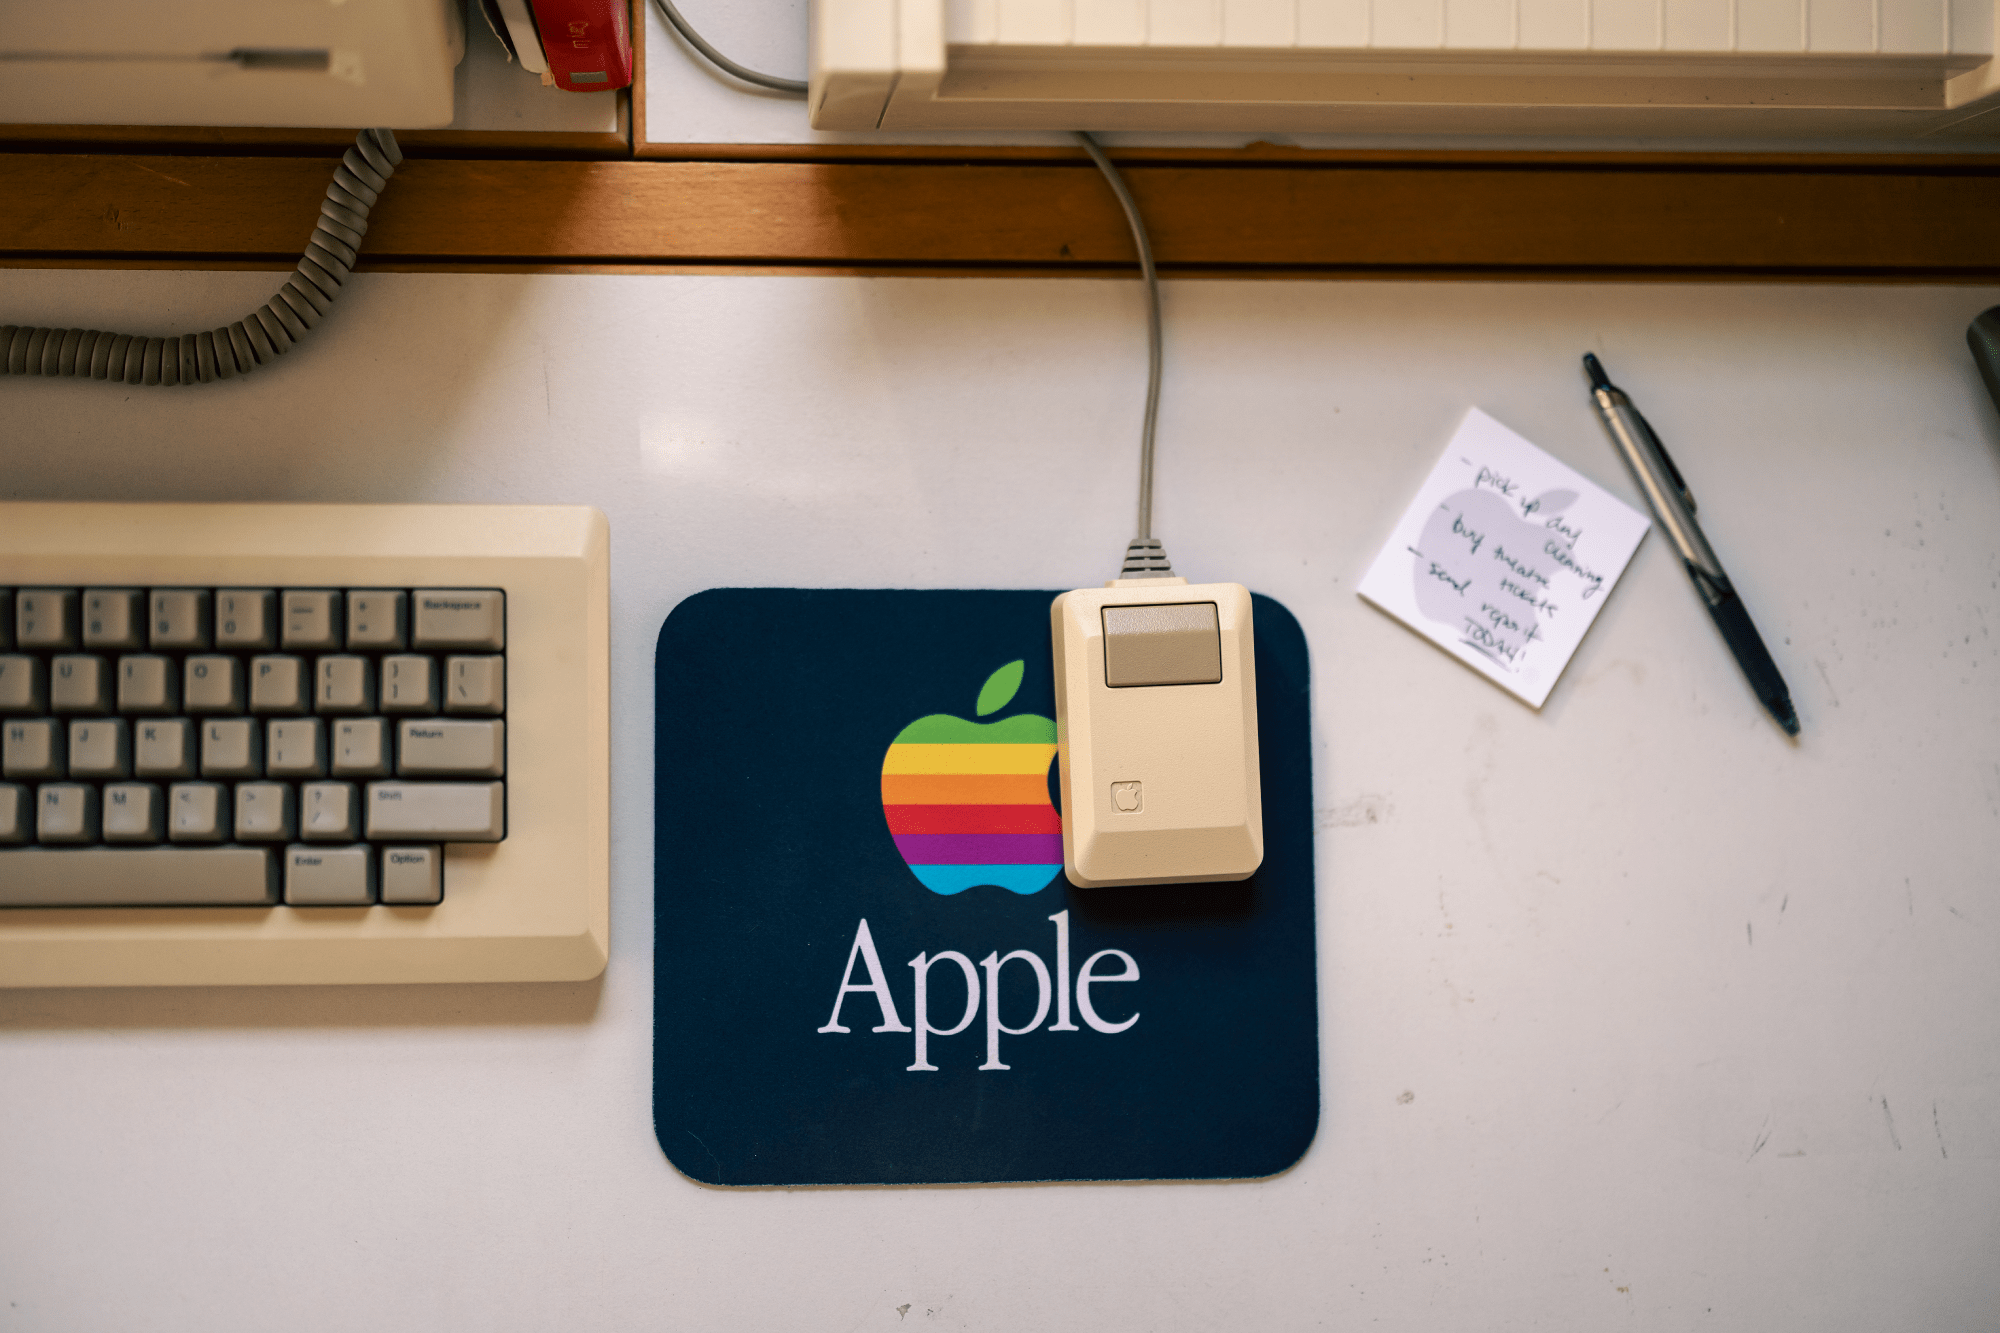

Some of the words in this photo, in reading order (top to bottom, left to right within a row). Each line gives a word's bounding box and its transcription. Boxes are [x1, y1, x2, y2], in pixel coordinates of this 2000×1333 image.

[1475, 465, 1519, 497] pick
[1520, 496, 1540, 517] up
[1452, 513, 1485, 554] buy
[1428, 562, 1472, 597] send
[423, 600, 482, 611] Backspace
[59, 663, 73, 679] U
[260, 663, 272, 678] P
[79, 727, 89, 743] J
[144, 726, 157, 741] K
[211, 725, 220, 741] L
[409, 728, 444, 739] Return
[46, 792, 59, 806] N
[378, 790, 402, 801] Shift
[295, 856, 322, 866] Enter
[390, 853, 425, 865] Option
[817, 909, 1140, 1072] Apple
